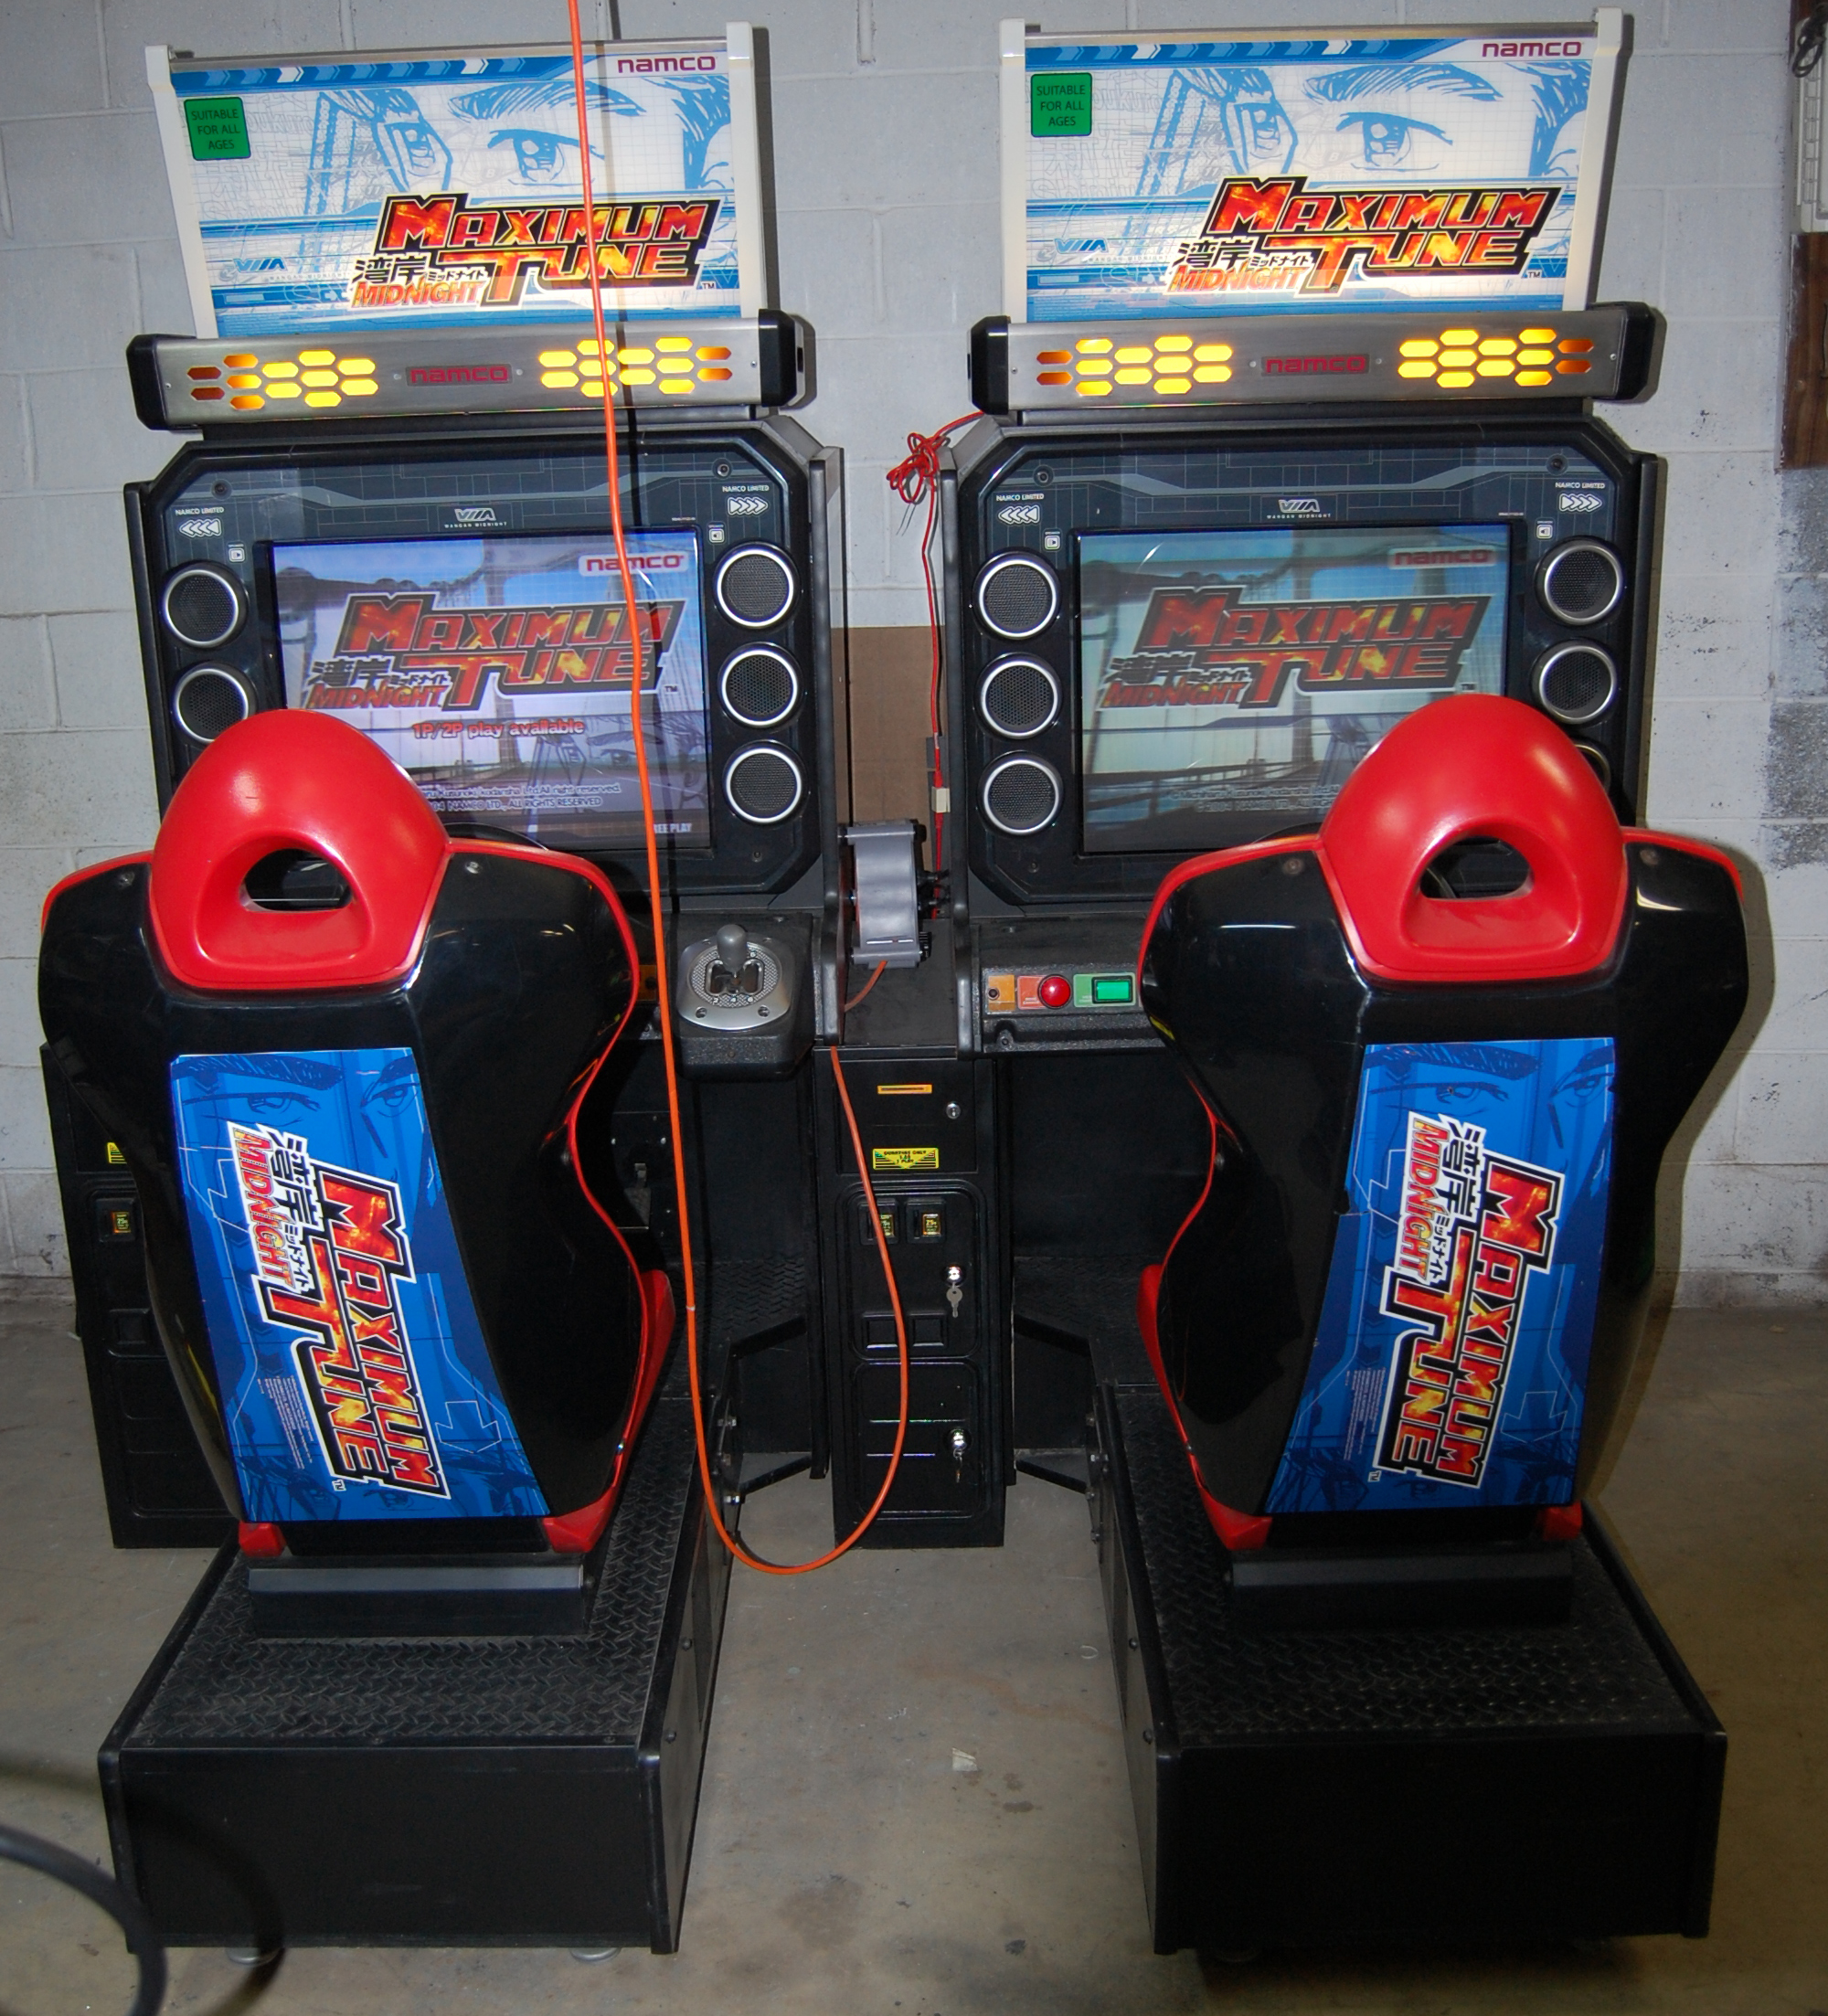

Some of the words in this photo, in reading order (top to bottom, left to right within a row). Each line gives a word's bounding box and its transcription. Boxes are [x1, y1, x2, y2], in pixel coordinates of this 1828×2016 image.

[617, 56, 717, 73] namco
[1482, 41, 1581, 57] namco
[1036, 85, 1085, 96] SUITABLE
[1040, 101, 1061, 111] FOR
[1065, 101, 1085, 111] ALL
[191, 109, 239, 120] SUITABLE
[197, 125, 218, 134] FOR
[221, 124, 240, 133] ALL
[1048, 116, 1076, 126] AGES
[208, 139, 235, 150] AGES
[1206, 181, 1550, 234] MAXIMUM
[379, 197, 710, 251] MAXIMUM
[436, 243, 691, 302] TUNE
[1167, 258, 1310, 292] MIDNIGHT
[1262, 231, 1525, 290] TUNE
[351, 276, 487, 308] MIDNIGHT
[410, 366, 508, 383] namco
[1266, 355, 1366, 374] namco
[586, 555, 685, 571] namco
[1394, 550, 1492, 567] namco
[343, 597, 673, 653] MAXIMUM
[1142, 592, 1478, 647] MAXIMUM
[400, 648, 653, 706] TUNE
[1202, 642, 1455, 703] TUNE
[306, 678, 450, 709] MIDNIGHT
[1100, 676, 1249, 708] MIDNIGHT
[411, 722, 463, 739] 1P/2P
[467, 720, 504, 738] play
[509, 718, 586, 736] available
[525, 798, 555, 809] RIGHTS
[557, 797, 602, 808] RESERVED
[670, 822, 692, 833] PLAY
[233, 1128, 296, 1289] MIDNIGHT
[1398, 1118, 1451, 1279] MIDNIGHT
[320, 1171, 441, 1488] MAXIMUM
[1436, 1162, 1555, 1479] MAXIMUM
[269, 1236, 390, 1476] TUNE
[1391, 1227, 1476, 1464] TUNE
